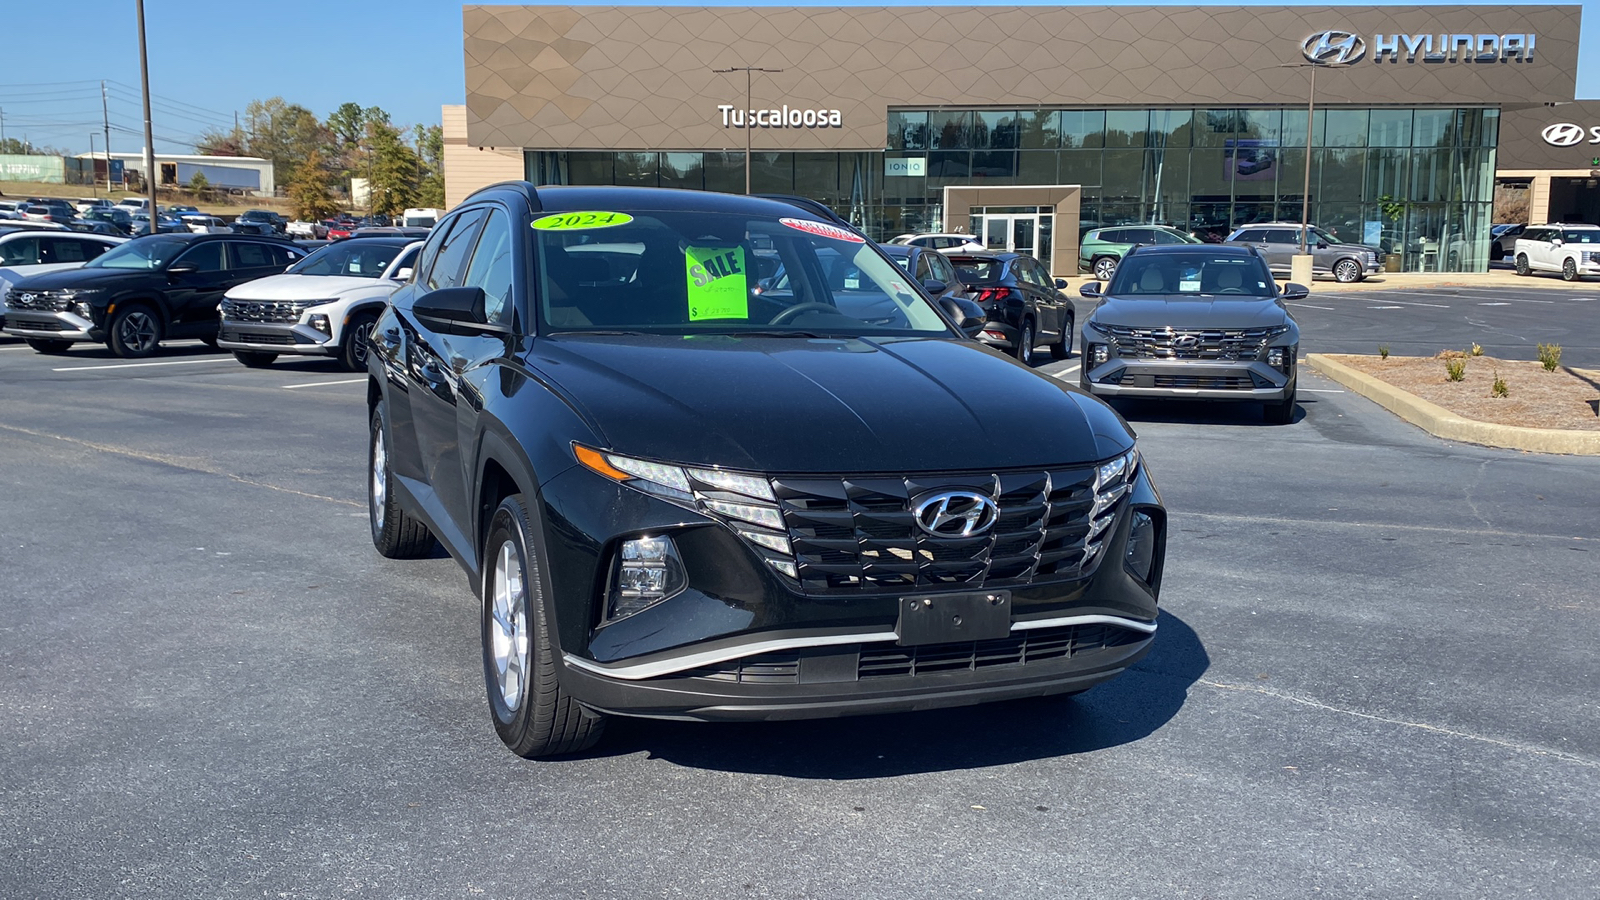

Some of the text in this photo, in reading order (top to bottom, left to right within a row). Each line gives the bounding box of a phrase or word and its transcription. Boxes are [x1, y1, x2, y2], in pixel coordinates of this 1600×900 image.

[1374, 33, 1536, 63] HYUNDAI
[717, 104, 842, 127] Tuscaloosa
[889, 163, 920, 171] IONIQ
[547, 213, 616, 228] 2024
[689, 251, 742, 287] SALE
[691, 306, 698, 317] $
